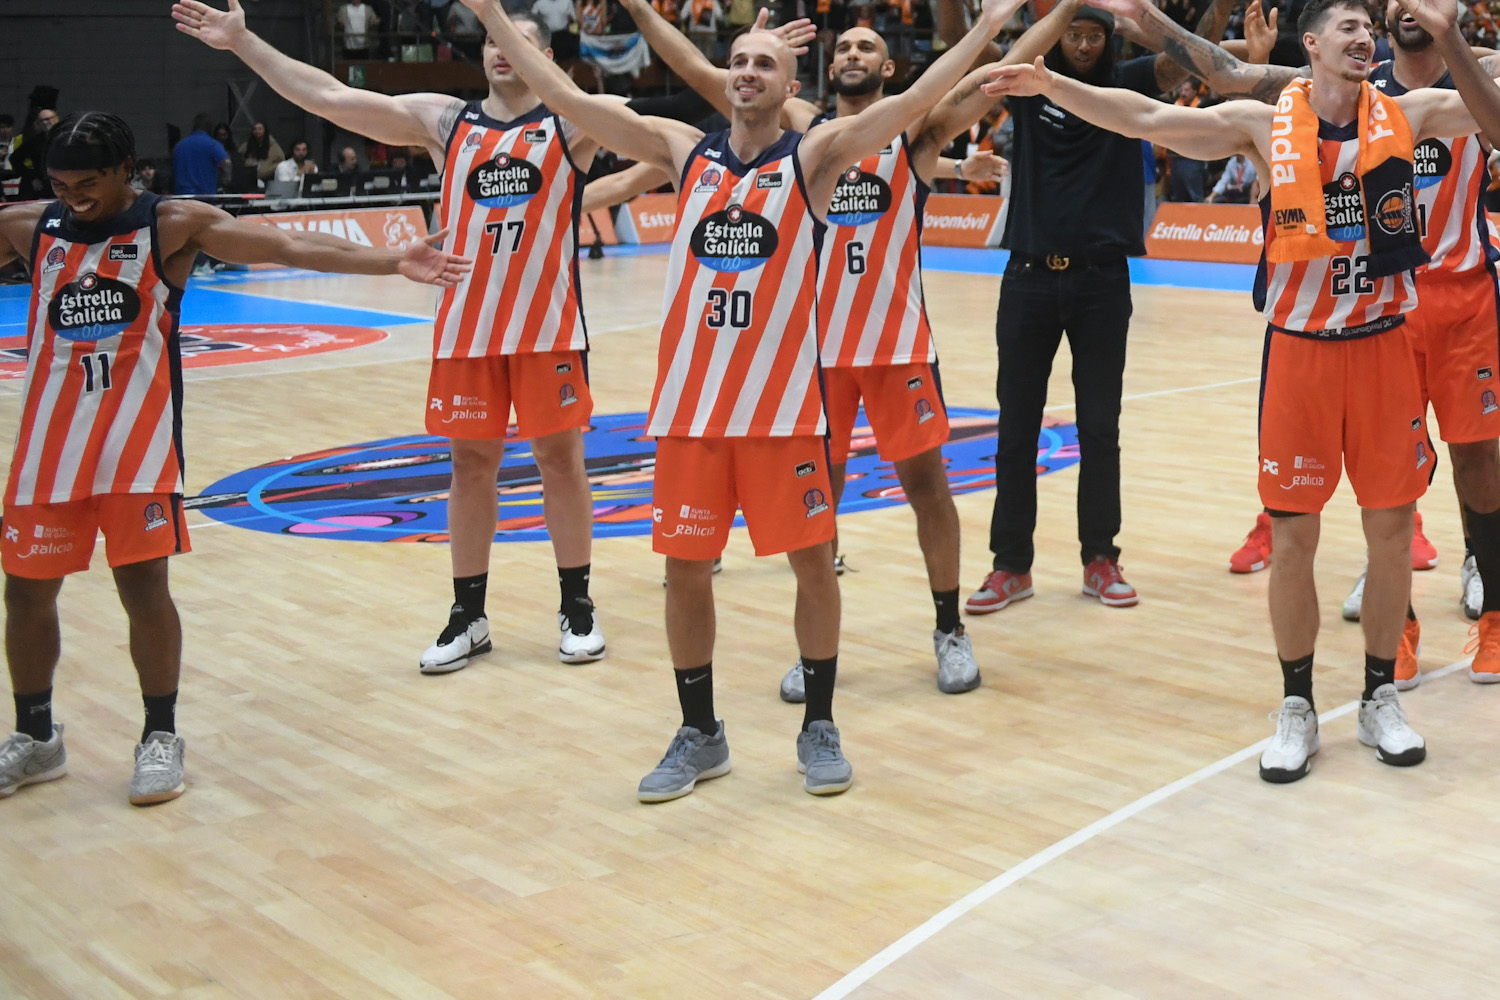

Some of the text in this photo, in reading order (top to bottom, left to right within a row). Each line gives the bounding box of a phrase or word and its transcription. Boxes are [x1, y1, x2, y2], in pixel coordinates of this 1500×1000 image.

[1414, 145, 1438, 159] ella
[478, 166, 530, 184] Estrella
[1414, 160, 1437, 174] icia
[479, 180, 528, 197] Galicia
[830, 196, 878, 212] Galicia
[485, 219, 526, 255] 77
[704, 221, 763, 239] Estrella
[1151, 222, 1202, 240] Estrella
[1203, 224, 1250, 243] Galicia
[704, 238, 760, 255] Galicia
[845, 240, 867, 275] 6
[1330, 255, 1374, 296] 22
[59, 288, 124, 310] Estrella
[60, 305, 122, 327] Galicia
[706, 288, 753, 330] 30
[79, 351, 112, 392] 11
[442, 410, 487, 423] galicia
[1280, 473, 1324, 489] galicia
[663, 523, 715, 537] galicia
[18, 541, 73, 558] galicia
